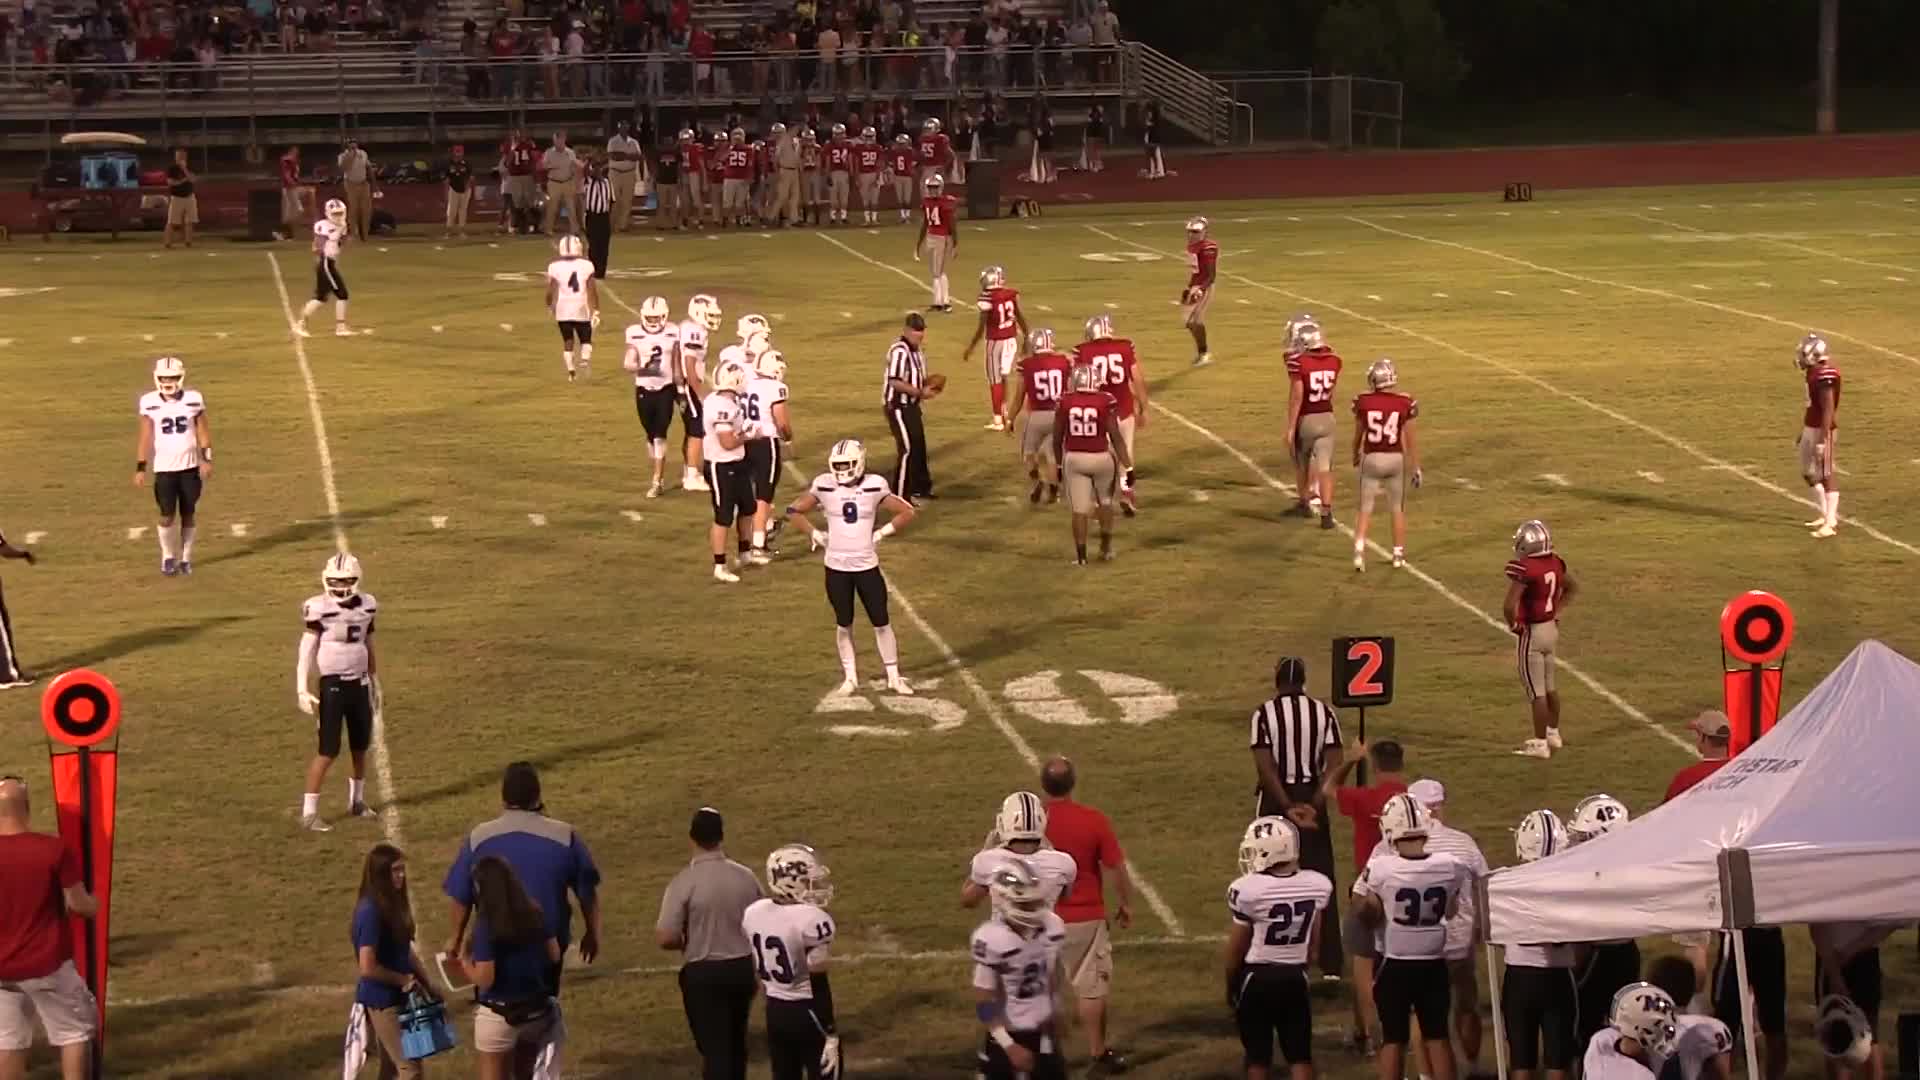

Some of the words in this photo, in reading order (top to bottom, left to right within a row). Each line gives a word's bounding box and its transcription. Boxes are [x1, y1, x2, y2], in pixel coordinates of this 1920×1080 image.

[729, 150, 746, 167] 25
[898, 156, 905, 170] 6
[926, 206, 941, 225] 14
[568, 271, 579, 292] 4
[998, 301, 1014, 329] 13
[1034, 370, 1062, 400] 50
[1069, 407, 1098, 436] 66
[1367, 411, 1400, 445] 54
[842, 501, 858, 524] 9
[1544, 572, 1556, 612] 7
[1347, 641, 1384, 696] 2
[1596, 806, 1616, 822] 42
[1393, 887, 1449, 926] 33
[816, 921, 833, 941] 13
[1264, 900, 1316, 945] 27
[753, 932, 795, 984] 13
